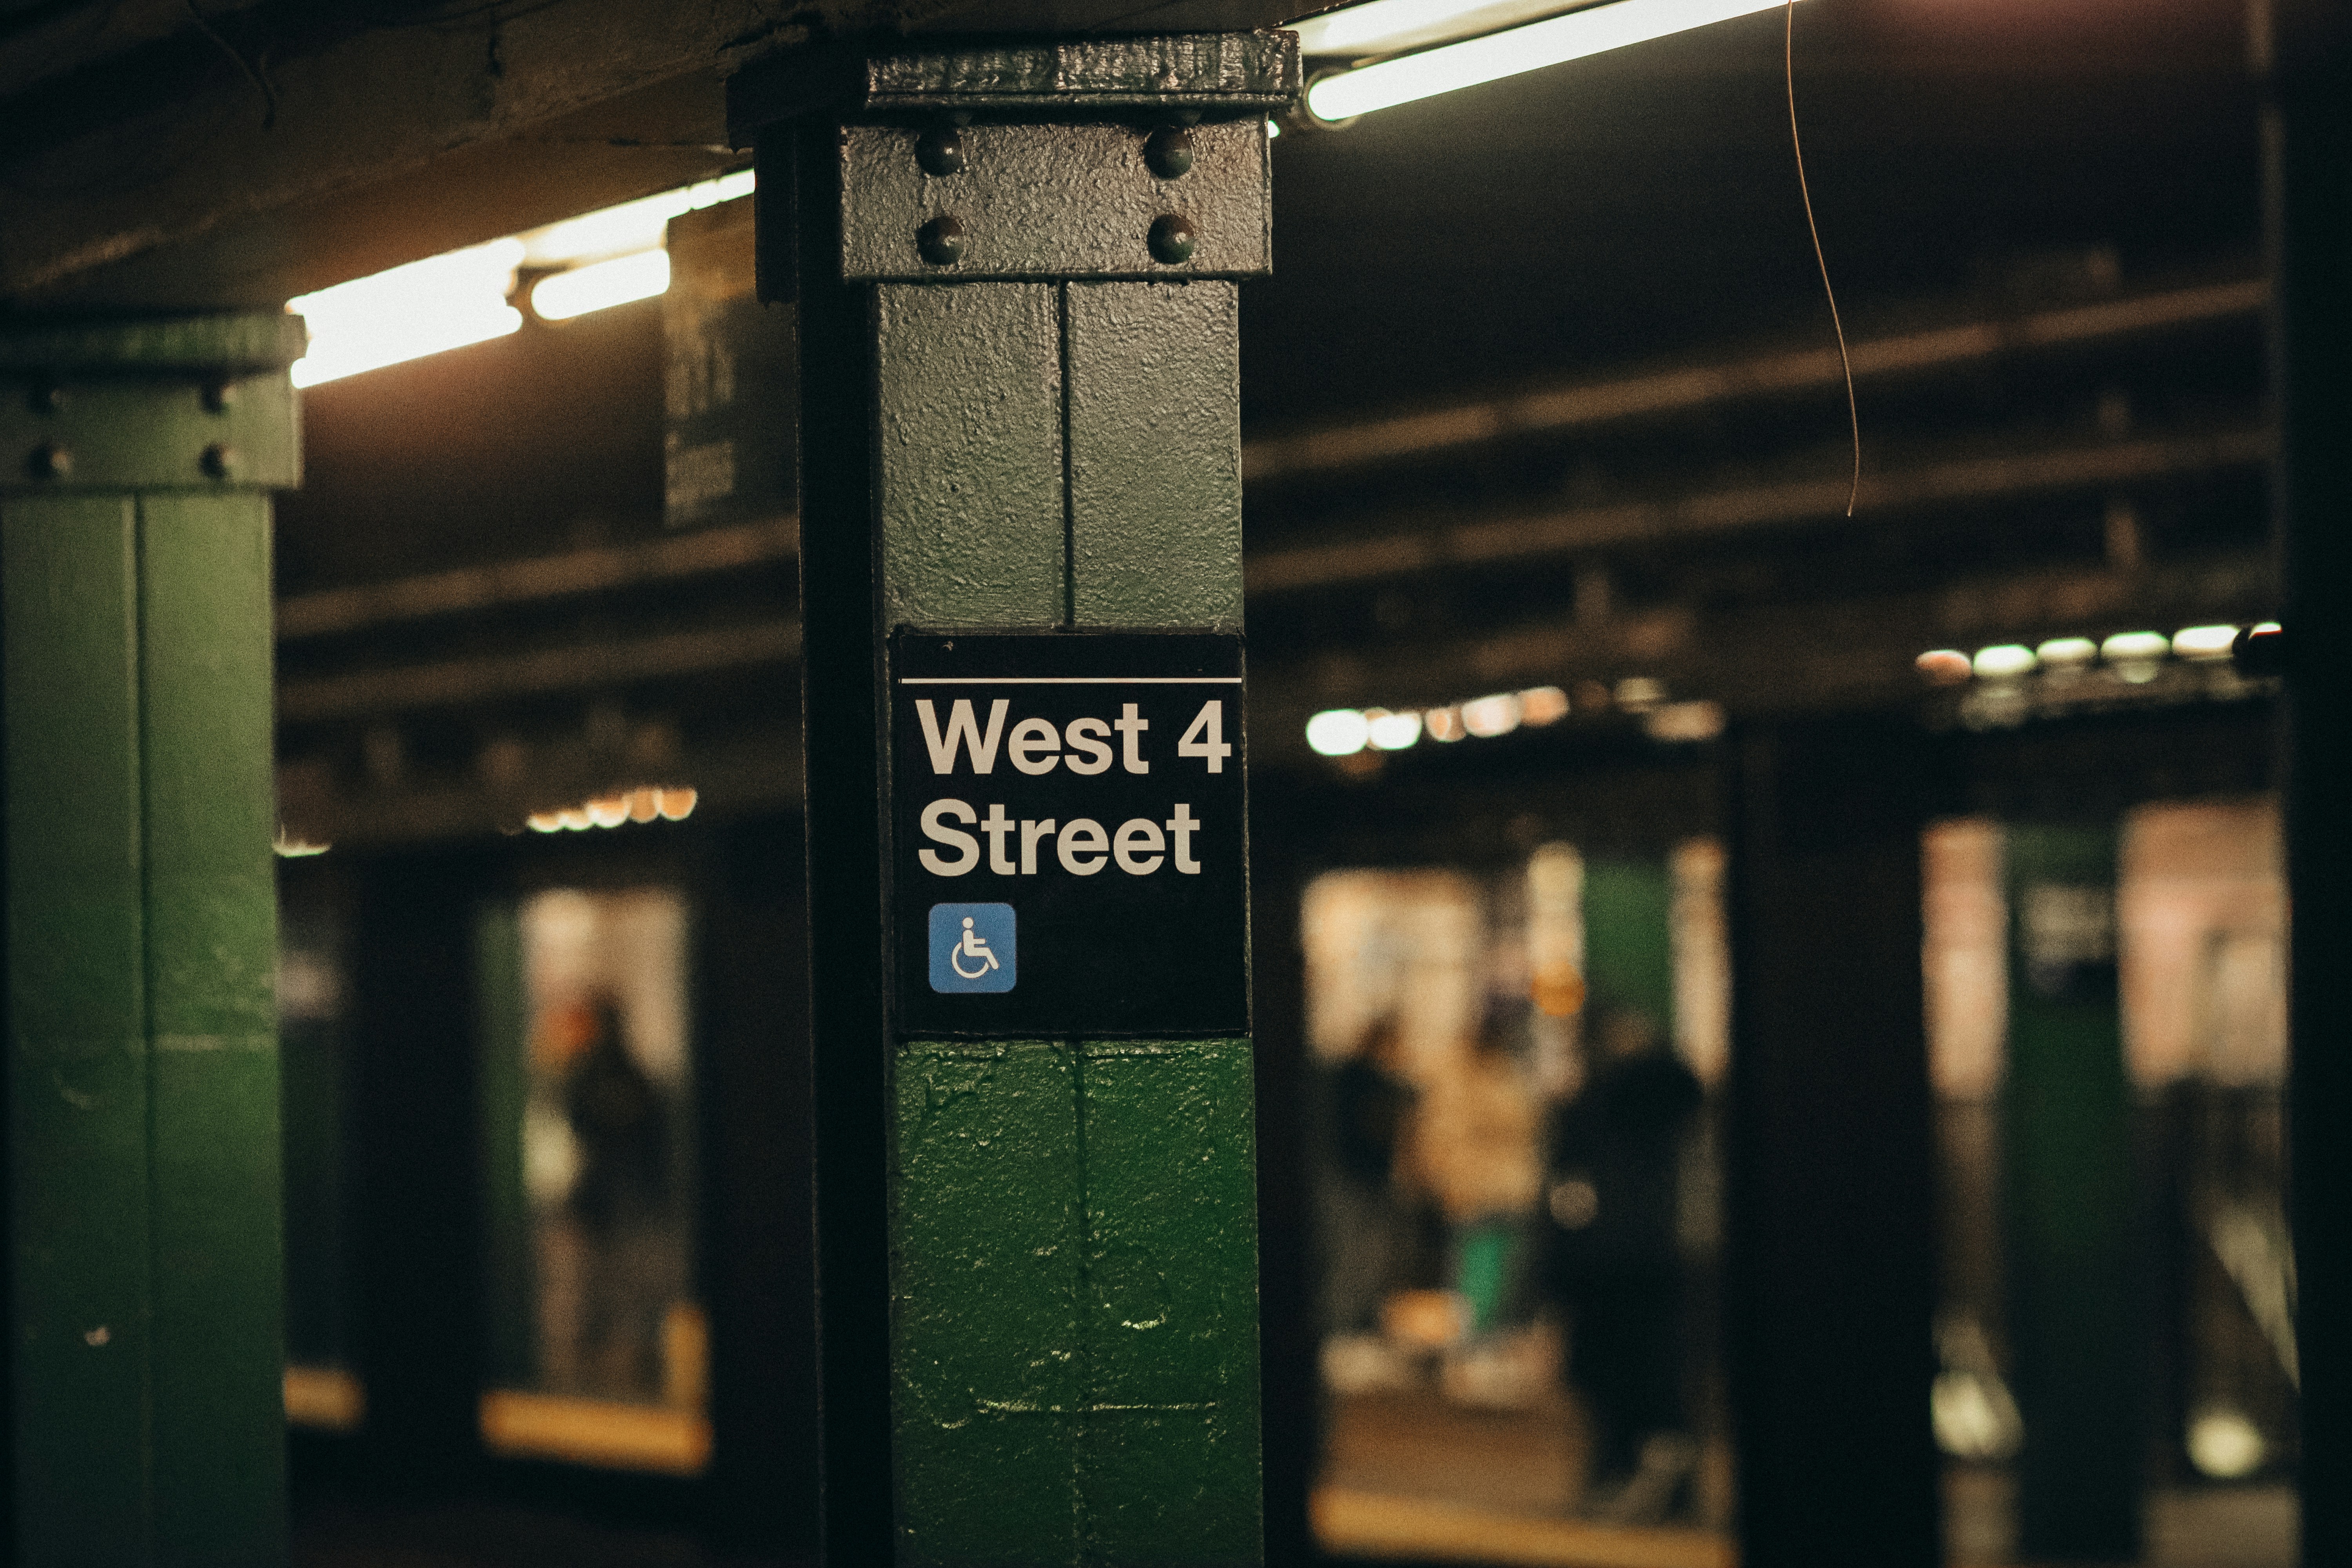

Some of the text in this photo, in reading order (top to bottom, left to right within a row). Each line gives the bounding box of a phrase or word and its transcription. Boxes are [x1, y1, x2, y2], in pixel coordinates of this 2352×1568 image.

[915, 699, 1231, 775] West 4
[919, 799, 1200, 876] Street
